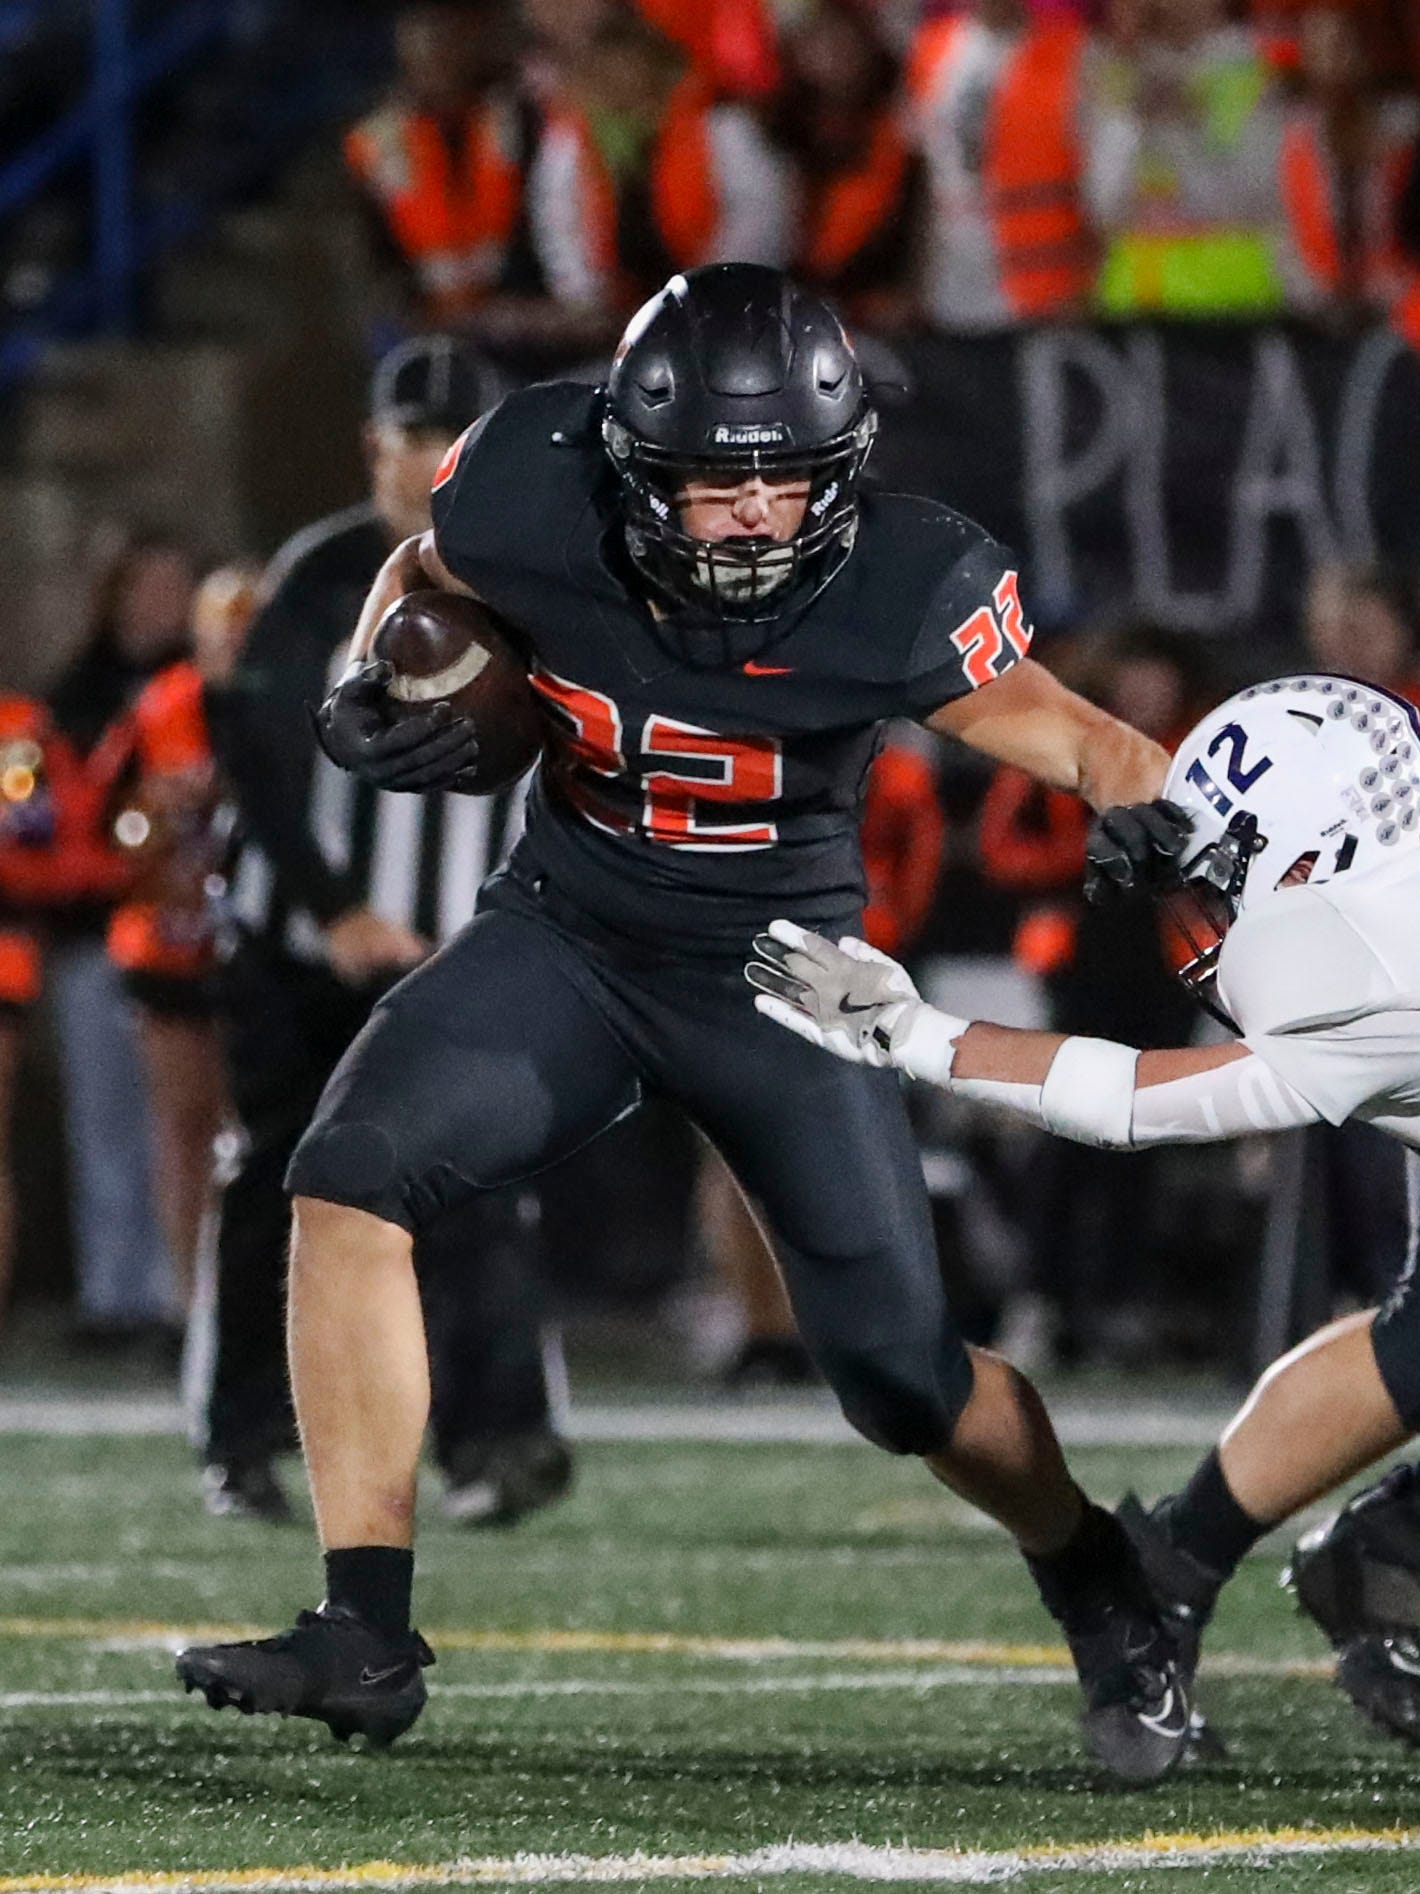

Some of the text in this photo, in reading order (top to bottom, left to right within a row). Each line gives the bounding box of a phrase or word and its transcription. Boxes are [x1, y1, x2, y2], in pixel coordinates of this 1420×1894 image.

[949, 569, 1034, 691] 22
[527, 671, 783, 852] 22
[1185, 720, 1274, 817] 12
